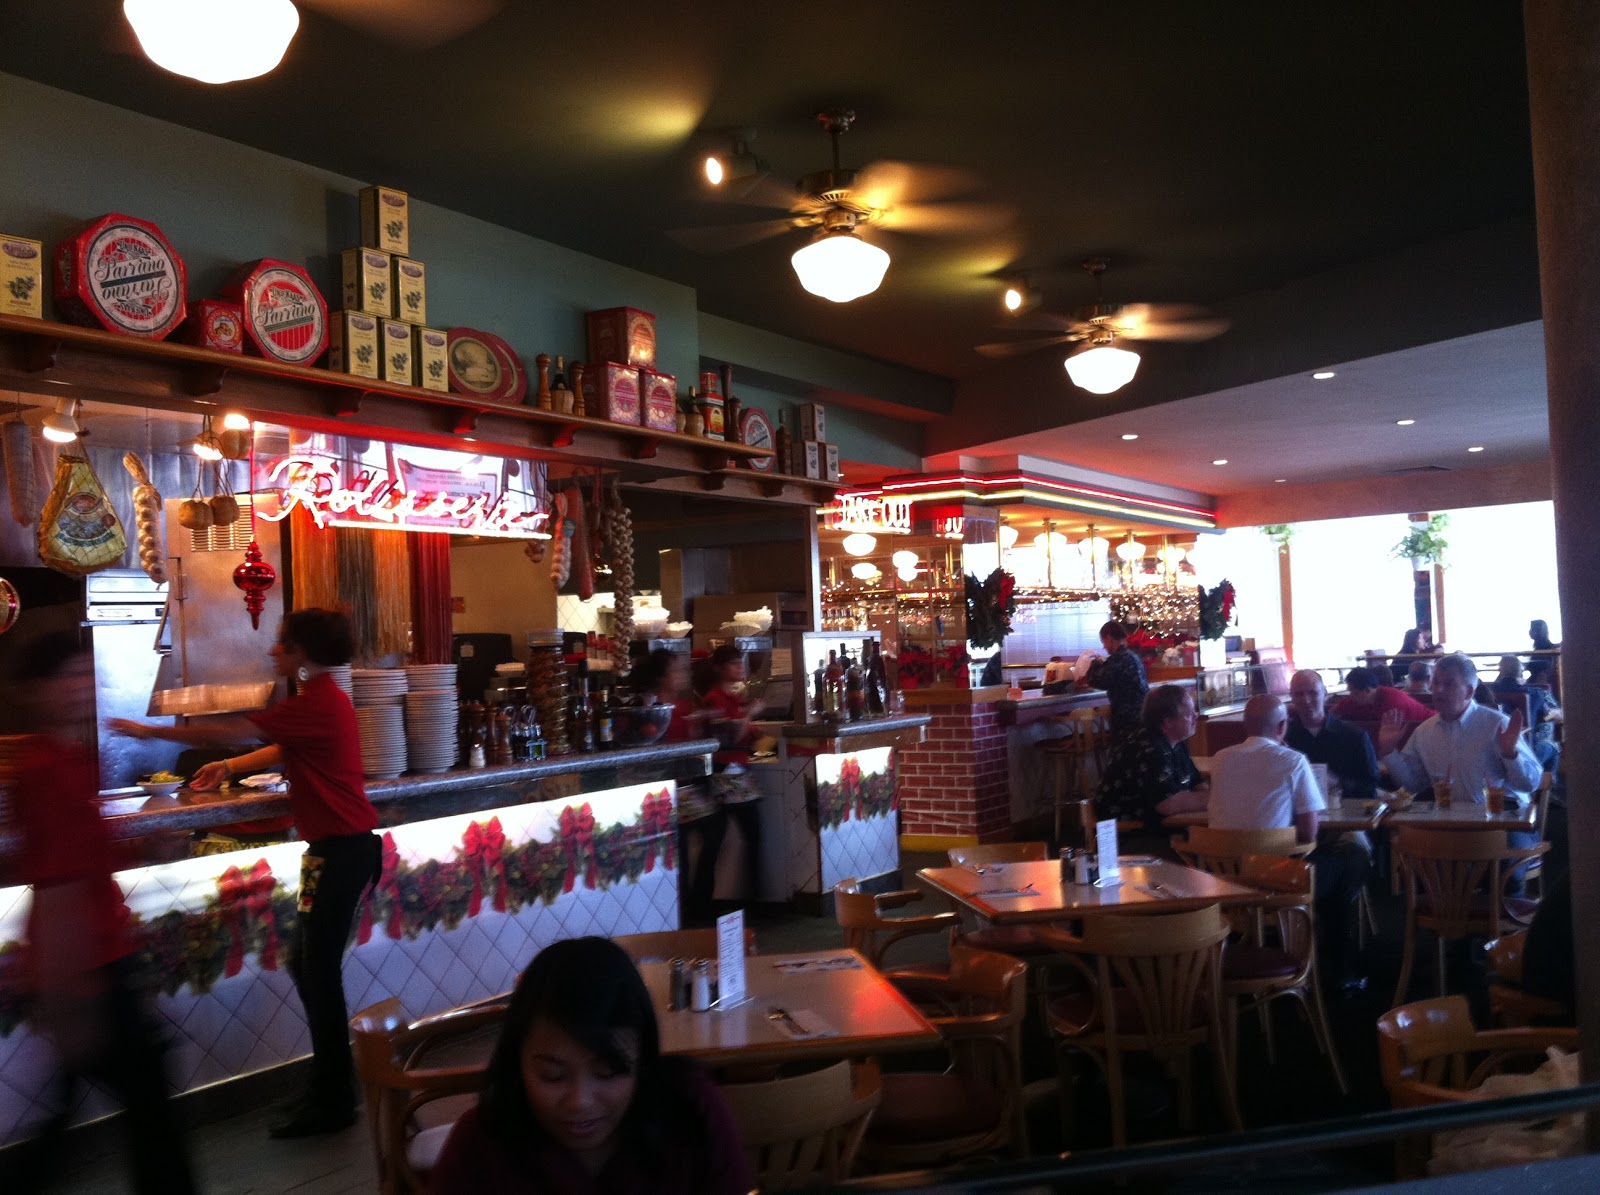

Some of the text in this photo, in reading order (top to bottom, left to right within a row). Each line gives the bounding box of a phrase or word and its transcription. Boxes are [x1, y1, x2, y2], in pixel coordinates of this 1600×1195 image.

[94, 255, 165, 282] Parrano
[102, 276, 173, 302] Parrano
[254, 303, 315, 327] Parrano
[882, 499, 913, 529] OUT
